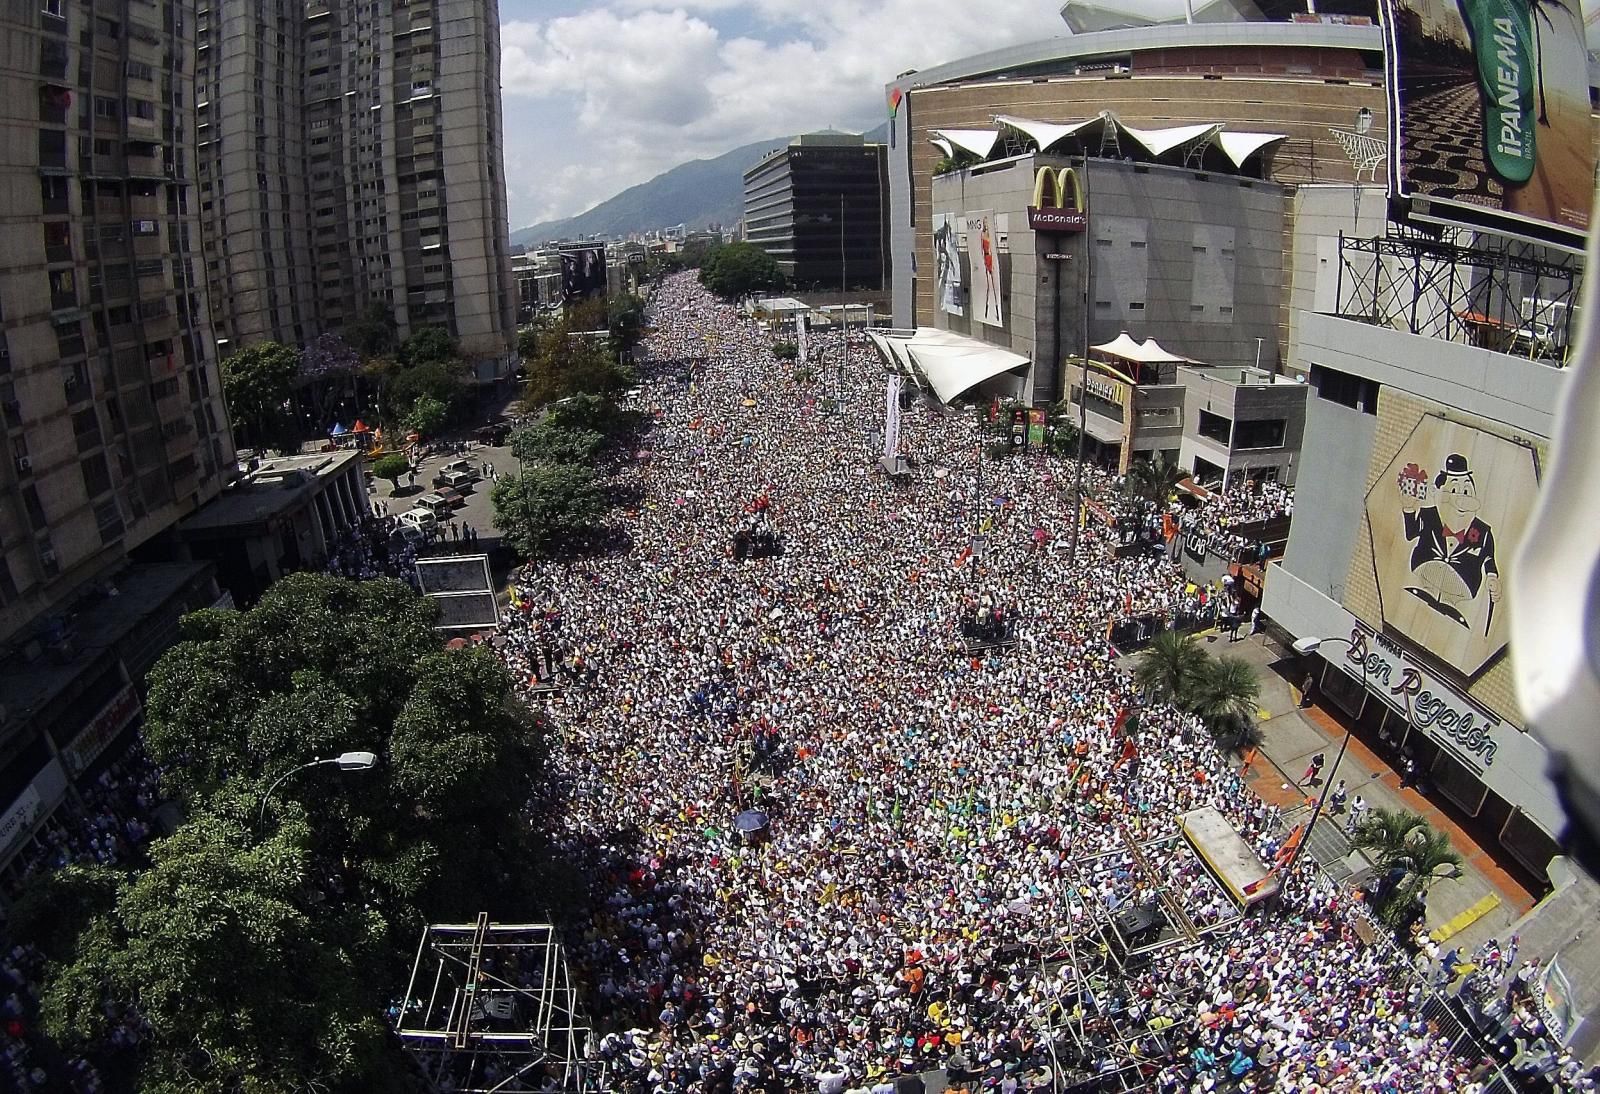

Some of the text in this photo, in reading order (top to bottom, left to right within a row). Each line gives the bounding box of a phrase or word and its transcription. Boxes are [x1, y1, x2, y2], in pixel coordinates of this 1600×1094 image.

[966, 219, 982, 231] MNG
[1033, 213, 1088, 225] McDonald's
[1346, 628, 1498, 767] Don Regalón
